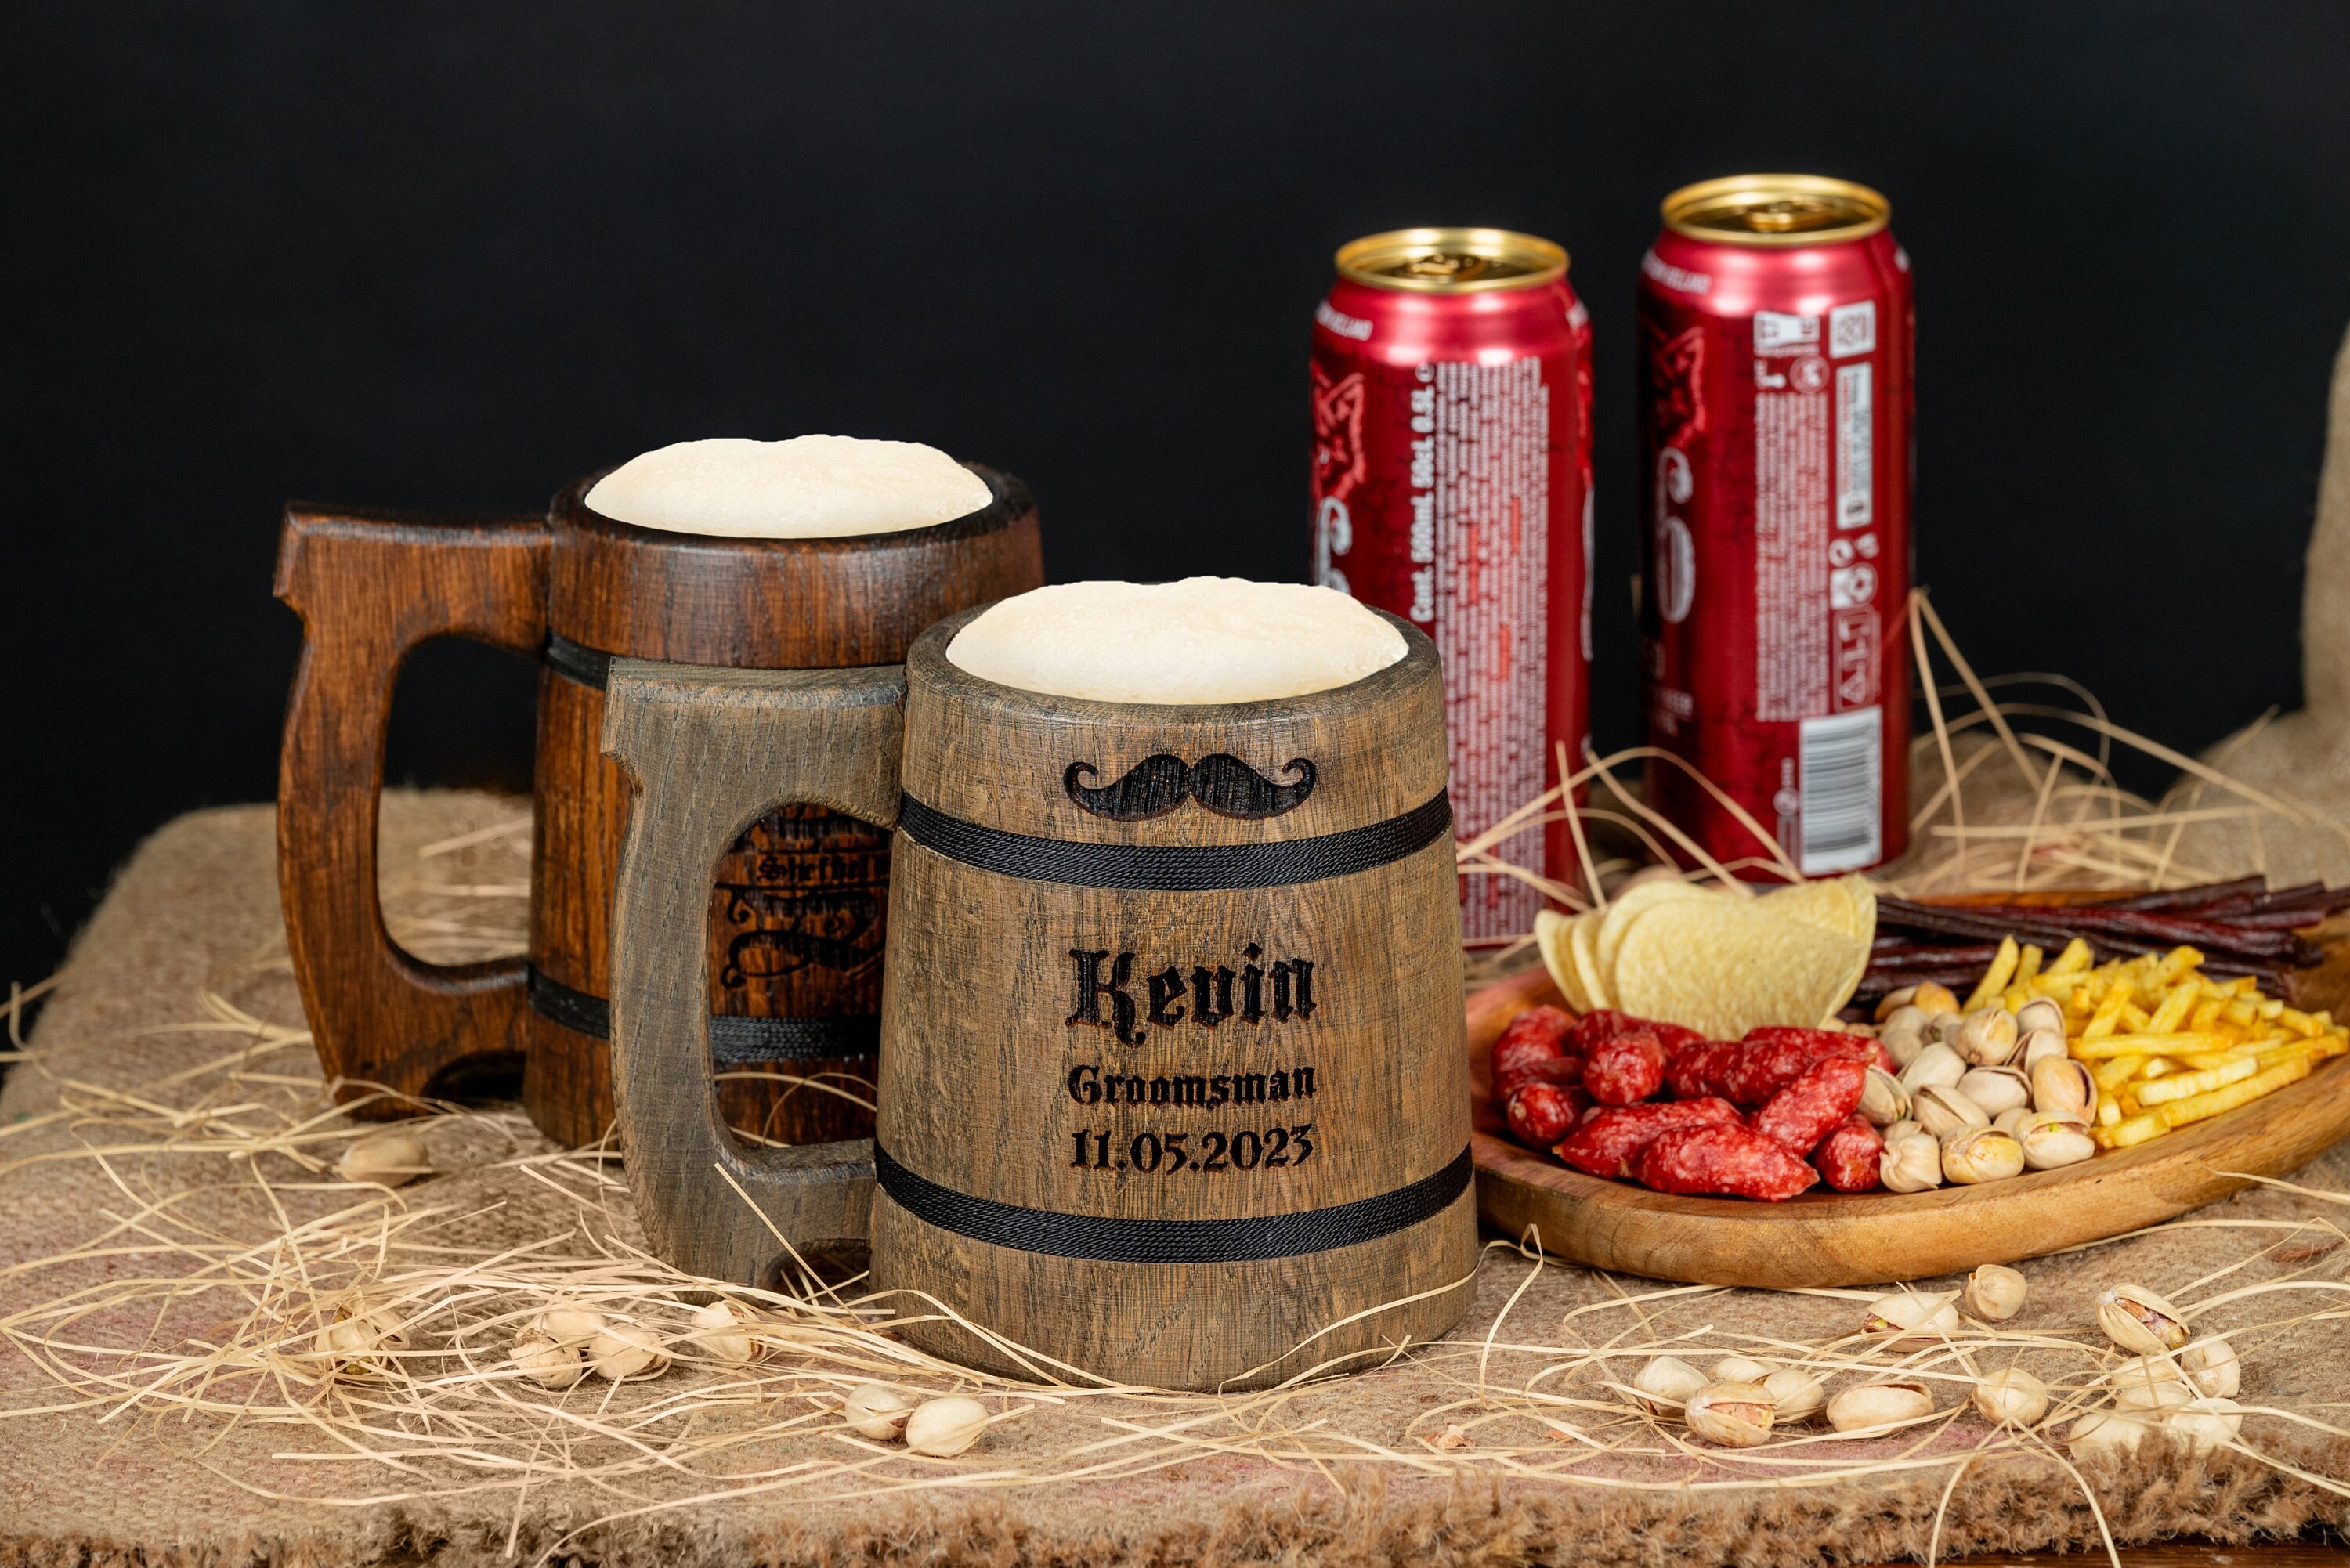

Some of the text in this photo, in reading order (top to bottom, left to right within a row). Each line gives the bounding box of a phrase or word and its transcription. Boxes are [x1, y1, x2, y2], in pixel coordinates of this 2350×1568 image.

[1065, 942, 1318, 1048] Kevin
[1066, 1064, 1317, 1110] Groomsman
[1070, 1123, 1314, 1176] 11.05.2023
